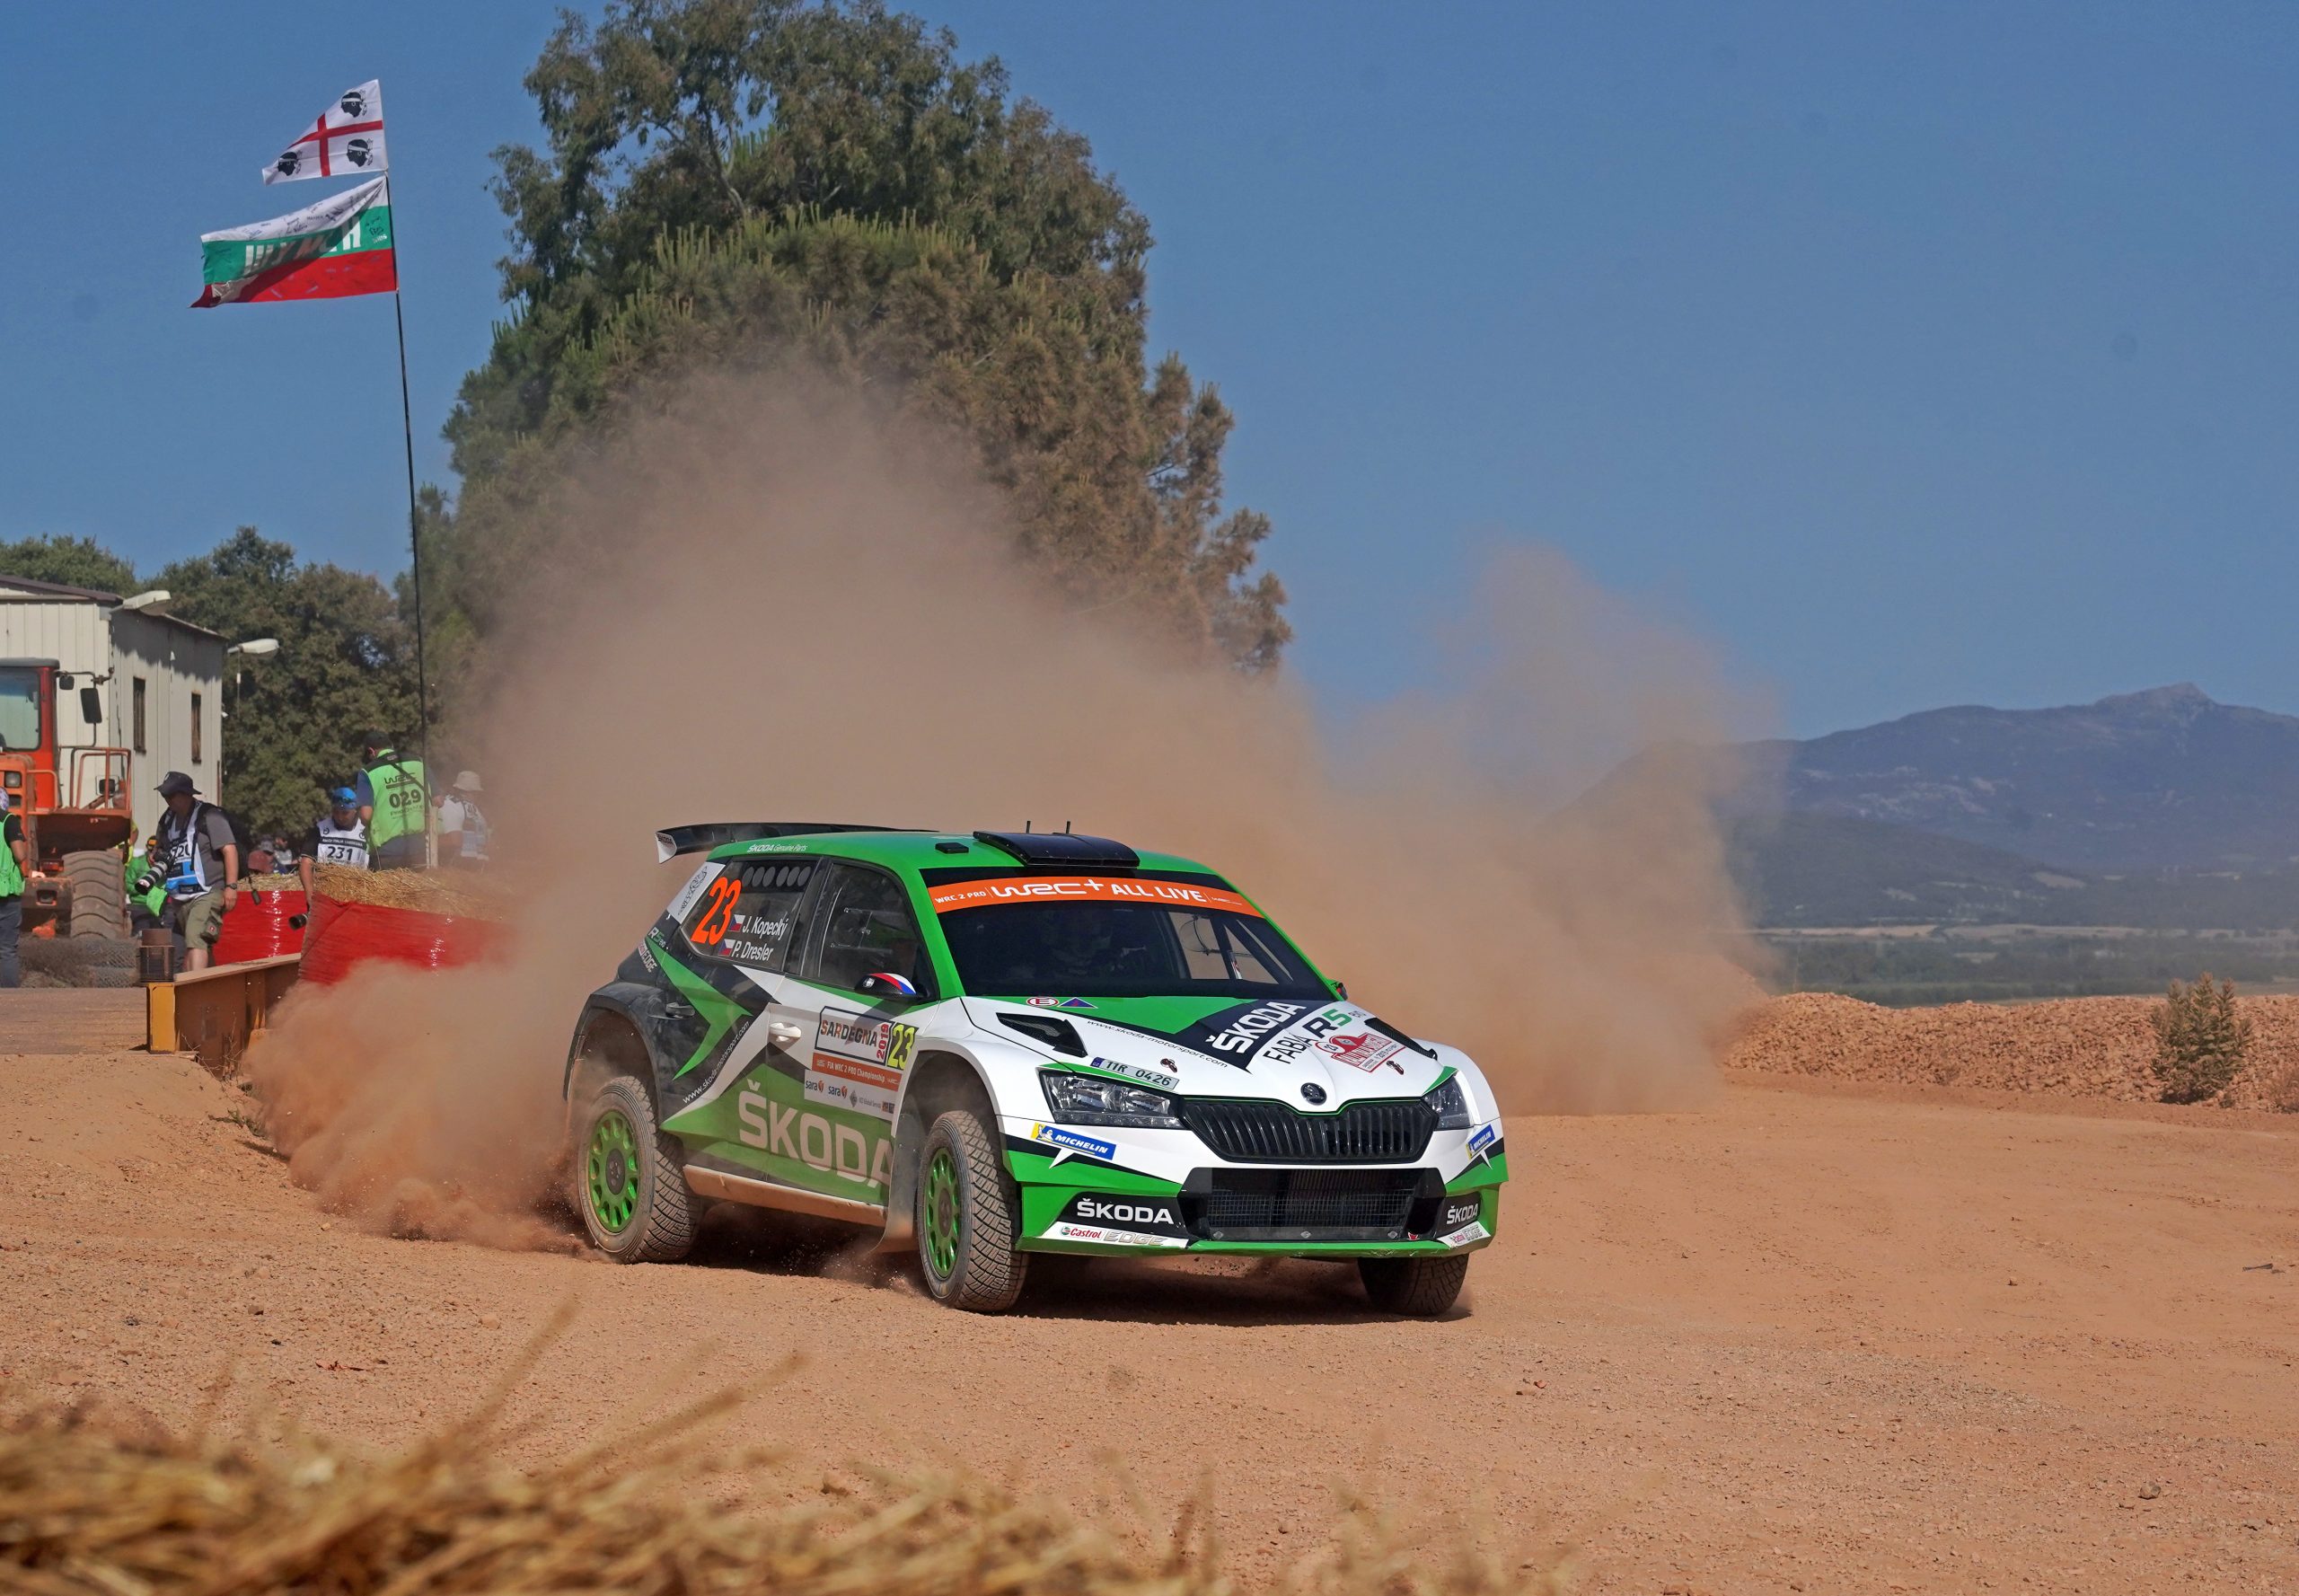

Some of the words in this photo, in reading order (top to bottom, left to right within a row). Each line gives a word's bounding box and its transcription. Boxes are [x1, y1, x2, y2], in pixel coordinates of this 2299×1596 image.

[389, 789, 421, 808] 029
[327, 845, 353, 861] 231
[746, 843, 773, 852] ŠKODA
[773, 844, 792, 852] Genuine
[792, 844, 808, 852] Parts
[935, 894, 956, 904] WRC
[967, 890, 986, 898] PRO
[1111, 883, 1154, 896] ALL
[1154, 886, 1207, 903] LIVE
[690, 876, 743, 946] 23
[647, 927, 665, 943] R5
[742, 915, 752, 933] J.
[753, 916, 788, 941] Kopecký
[643, 948, 657, 973] EDGE
[732, 942, 741, 957] P.
[741, 942, 773, 962] Dresler
[1034, 998, 1050, 1006] E
[1205, 1001, 1307, 1054] ŠKODA
[1262, 1031, 1318, 1064] FABIA
[1302, 1009, 1352, 1039] R5
[820, 1019, 878, 1047] SARDEGNA
[876, 1023, 890, 1060] 2019
[887, 1024, 915, 1070] 23
[1087, 1019, 1229, 1068] www.skoda-motorsport.com
[844, 1064, 848, 1073] 2
[1135, 1070, 1173, 1087] 0426
[805, 1079, 818, 1092] sara
[828, 1084, 841, 1097] sara
[738, 1078, 894, 1188] ŠKODA
[1473, 1131, 1492, 1150] MICHELIN
[1054, 1133, 1108, 1154] MICHELIN
[1077, 1197, 1175, 1225] ŠKODA
[1446, 1204, 1479, 1225] ŠKODA
[1070, 1227, 1102, 1239] Castrol
[1103, 1230, 1167, 1246] EDGE
